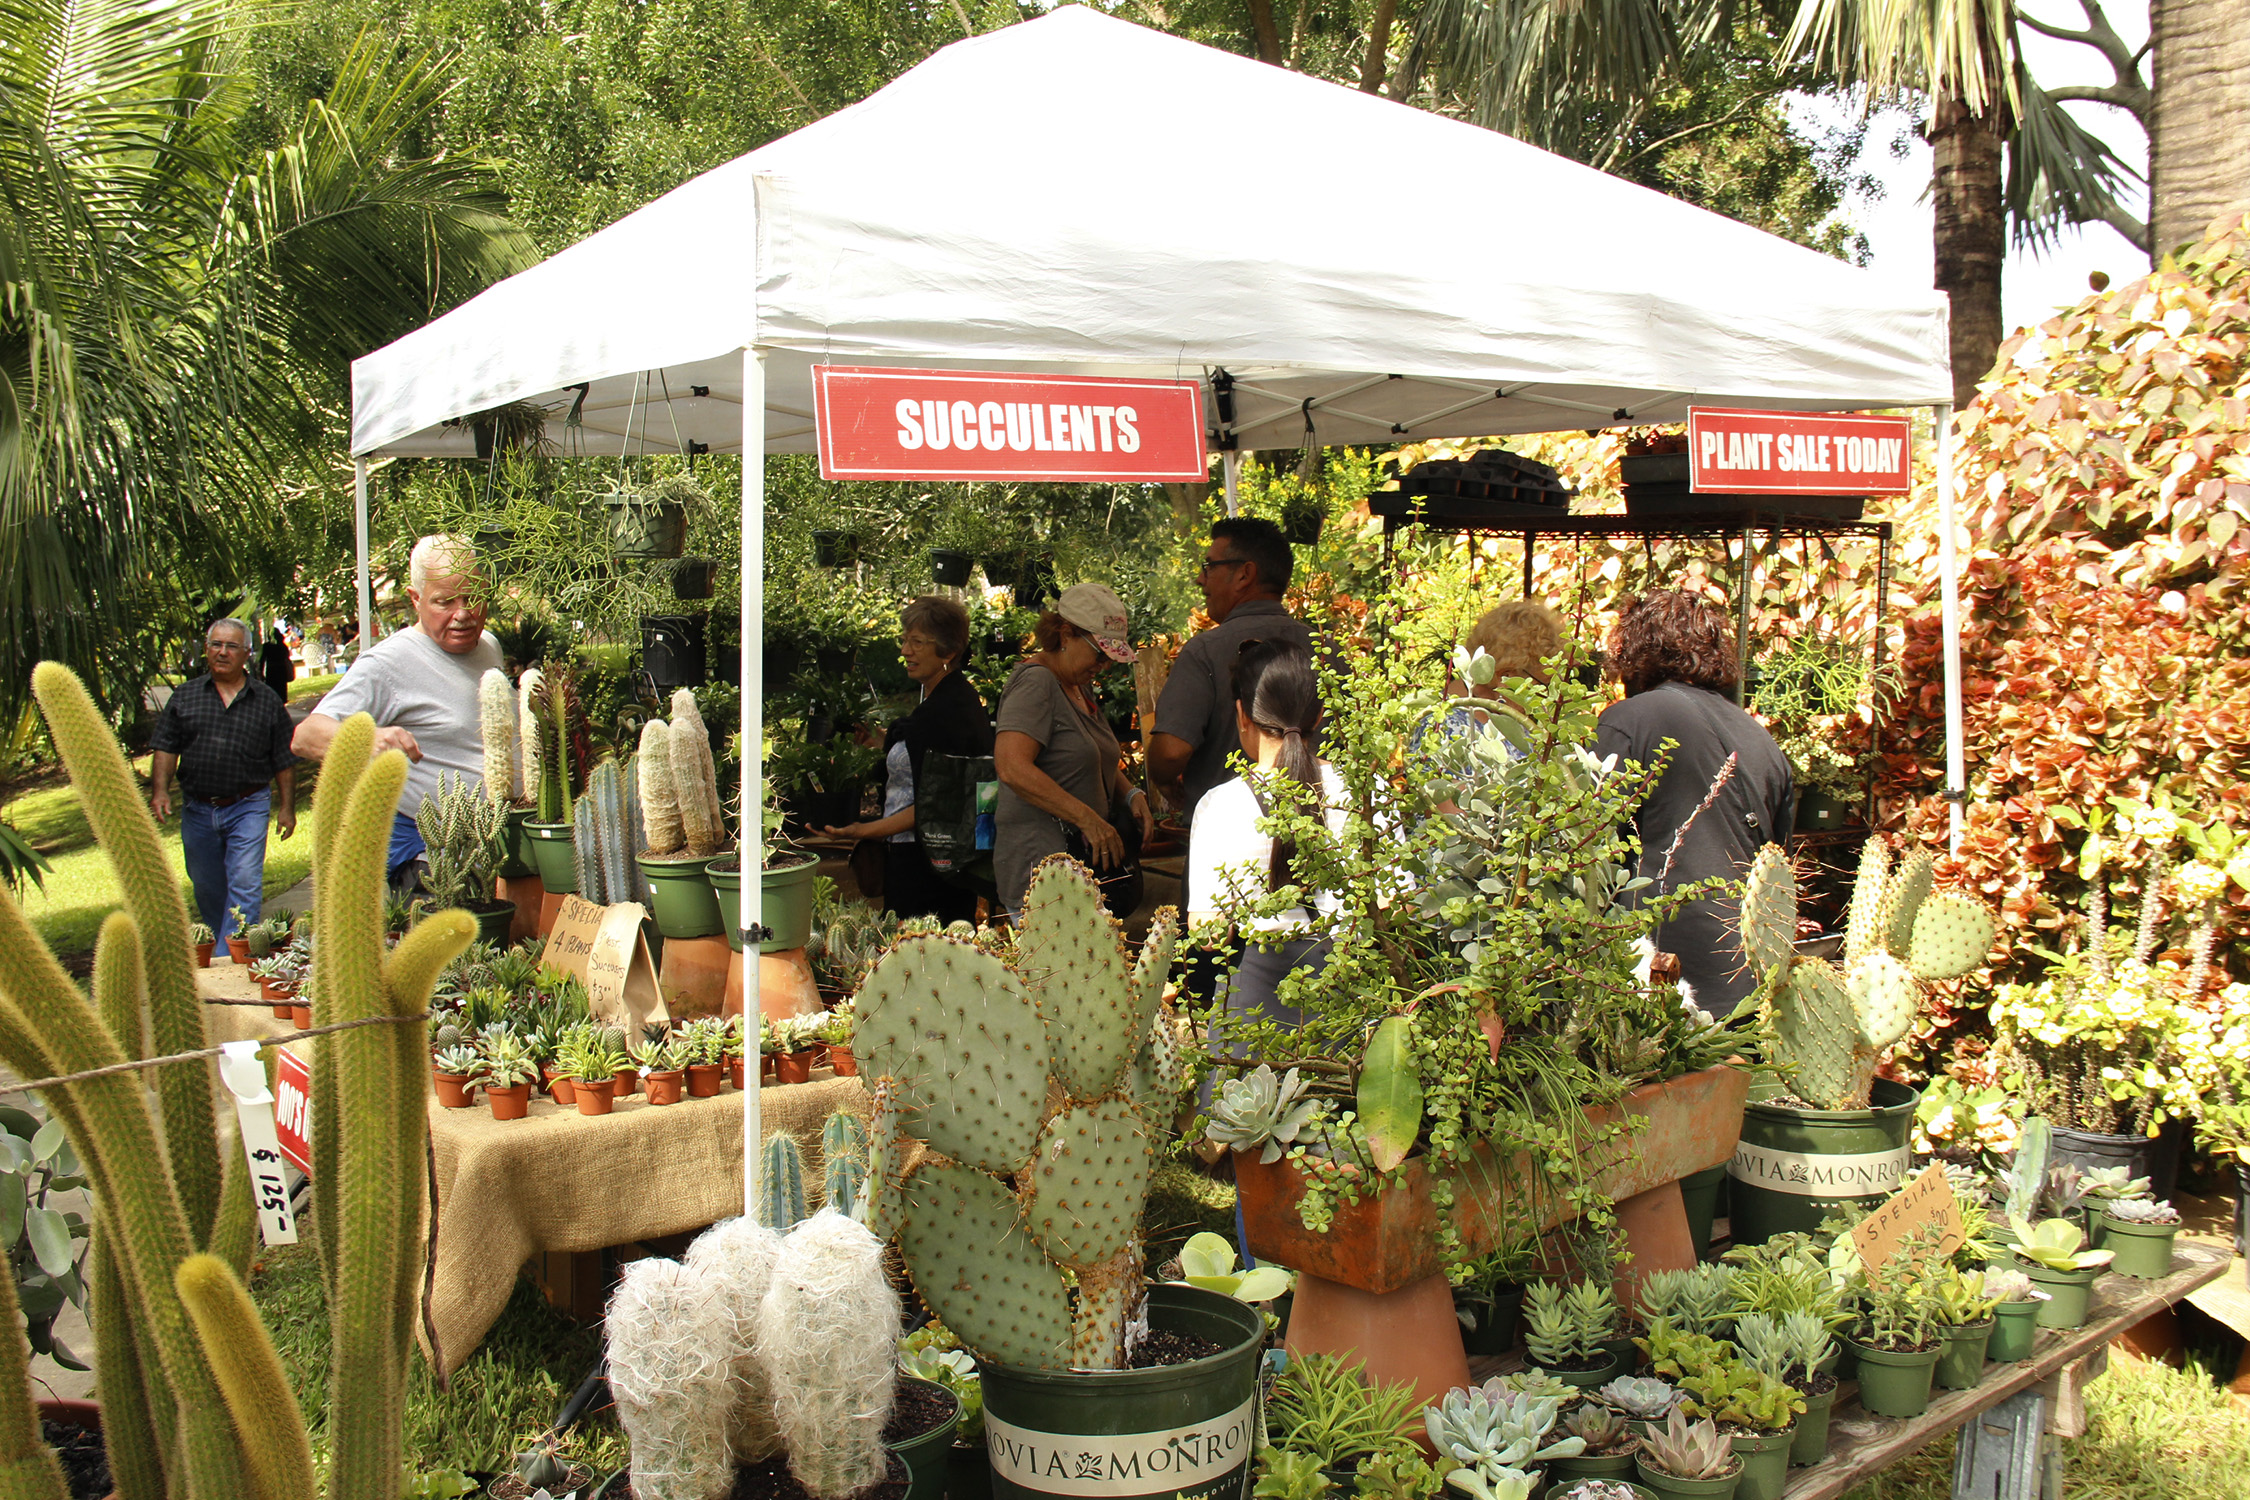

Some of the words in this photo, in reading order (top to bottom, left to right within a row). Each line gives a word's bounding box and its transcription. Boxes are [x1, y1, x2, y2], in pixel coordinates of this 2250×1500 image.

[895, 398, 1141, 454] SUCCULENTS
[1700, 431, 1773, 471] PLANT
[1777, 433, 1831, 472] SALE
[1833, 436, 1903, 474] TODAY
[554, 930, 565, 954] 4
[564, 935, 593, 956] PLANTS
[277, 1079, 304, 1138] 100'S
[1731, 1150, 1786, 1182] OVIA
[1867, 1177, 1936, 1241] SPECIAL
